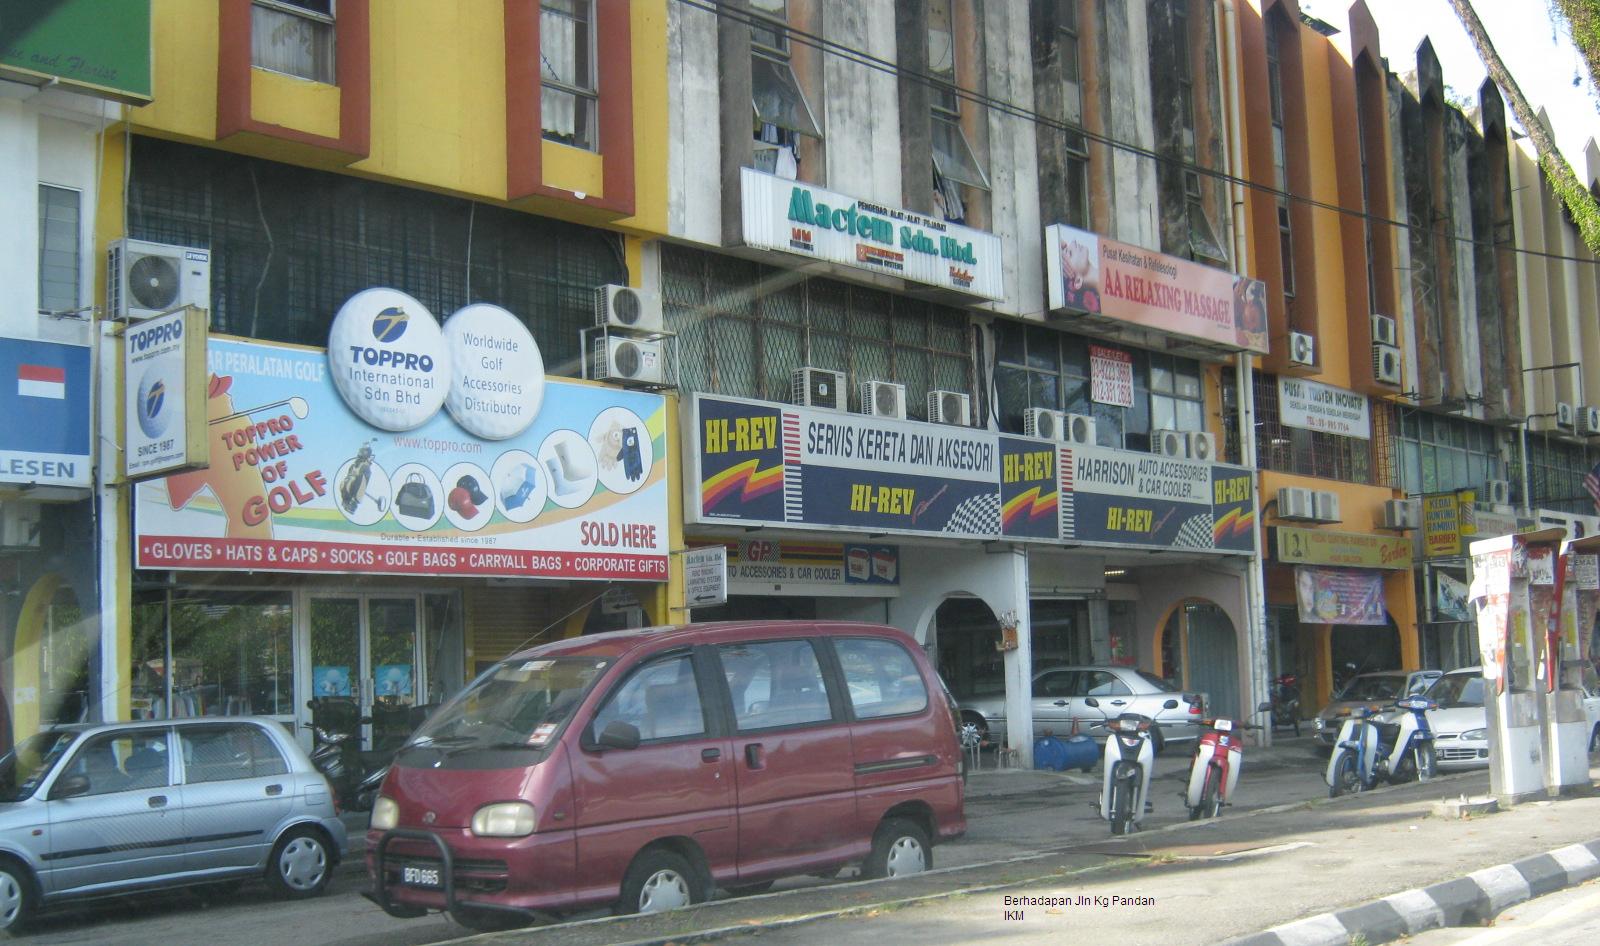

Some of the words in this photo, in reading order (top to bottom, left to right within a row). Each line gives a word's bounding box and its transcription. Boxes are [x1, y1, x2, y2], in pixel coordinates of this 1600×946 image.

[1124, 275, 1181, 312] RELAXING
[1184, 289, 1231, 324] MASSAGE
[130, 319, 183, 354] TOPPRO
[463, 332, 518, 353] Worldwide
[225, 352, 292, 380] PERALATAN
[295, 360, 326, 383] GOLF
[350, 346, 433, 373] TOPPRO
[481, 356, 503, 371] Golf
[350, 367, 434, 389] International
[463, 375, 522, 395] Accessories
[364, 387, 390, 402] Sdn
[395, 389, 421, 405] Bhd
[465, 397, 522, 416] Distributor
[222, 414, 294, 450] TOPPRO
[394, 436, 482, 454] www.toppro.com
[705, 416, 778, 453] HI-REV
[232, 434, 303, 471] POWER
[807, 421, 853, 458] SERVIS
[858, 428, 906, 464] KERETA
[910, 434, 933, 466] DAN
[937, 437, 993, 472] AKSESORI
[262, 460, 288, 483] OF
[1003, 452, 1052, 483] HI-REV
[1077, 457, 1134, 486] HARRISON
[1138, 459, 1158, 476] AUTO
[1159, 462, 1208, 483] ACCESSORIES
[242, 469, 328, 526] GOLF
[850, 483, 914, 515] HI-REV
[1138, 481, 1144, 493] &
[1145, 481, 1161, 495] CAR
[1163, 482, 1192, 497] COOLER
[1214, 476, 1250, 504] HI-REV
[1107, 507, 1152, 533] HI-REV
[581, 521, 619, 548] SOLD
[622, 523, 657, 549] HERE
[1429, 534, 1457, 545] BARBER
[153, 543, 212, 560] GLOVES
[226, 545, 262, 561] HATS
[268, 547, 277, 561] &
[282, 547, 318, 563] CAPS
[330, 549, 374, 564] SOCKS
[386, 551, 419, 566] GOLF
[423, 553, 457, 567] BAGS
[469, 554, 527, 569] CARRYALL
[532, 556, 562, 570] BAGS
[575, 557, 636, 572] CORPORATE
[638, 559, 665, 573] GIFTS
[748, 540, 772, 561] GP
[740, 566, 787, 579] ACCESSORIES
[789, 567, 794, 578] &
[798, 568, 812, 580] CAR
[814, 568, 841, 580] COOLER
